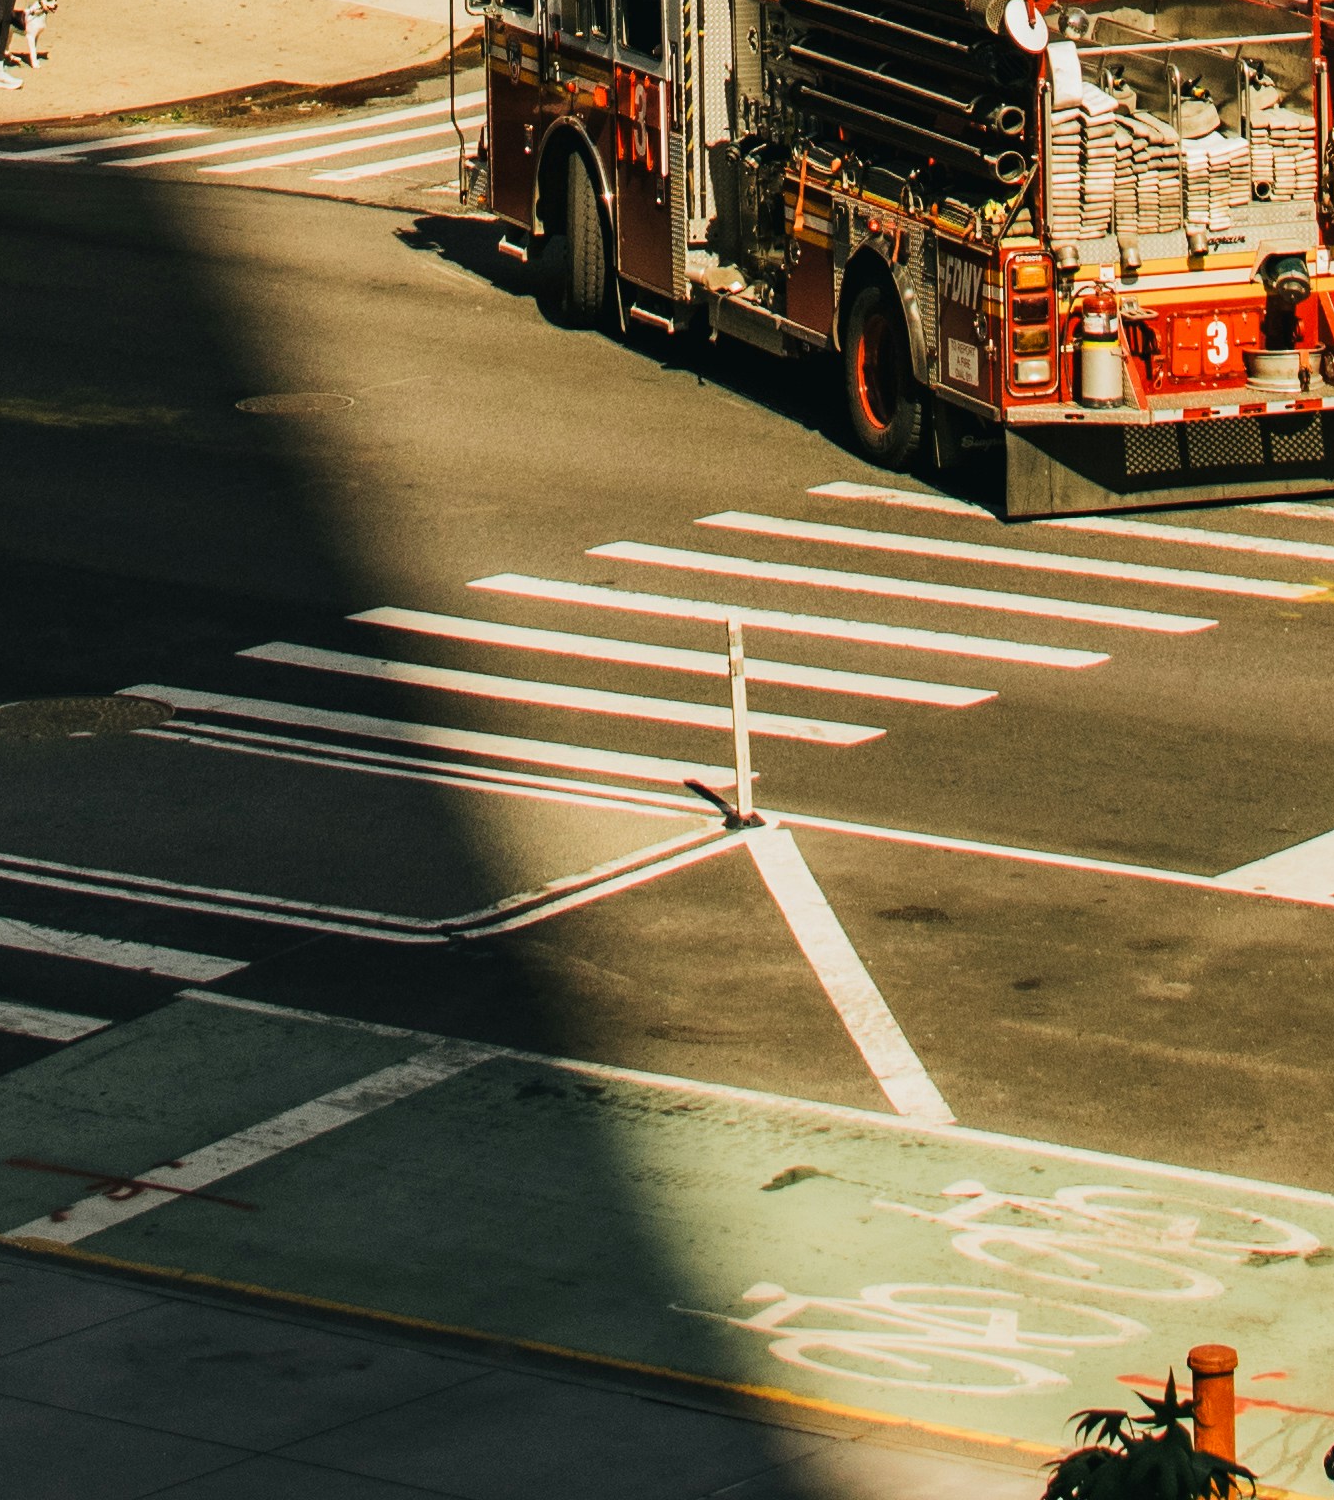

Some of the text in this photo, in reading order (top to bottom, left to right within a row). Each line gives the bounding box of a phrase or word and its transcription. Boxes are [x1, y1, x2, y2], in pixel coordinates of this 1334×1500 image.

[635, 82, 650, 158] 3
[943, 254, 983, 310] FDNY
[1206, 320, 1229, 366] 3
